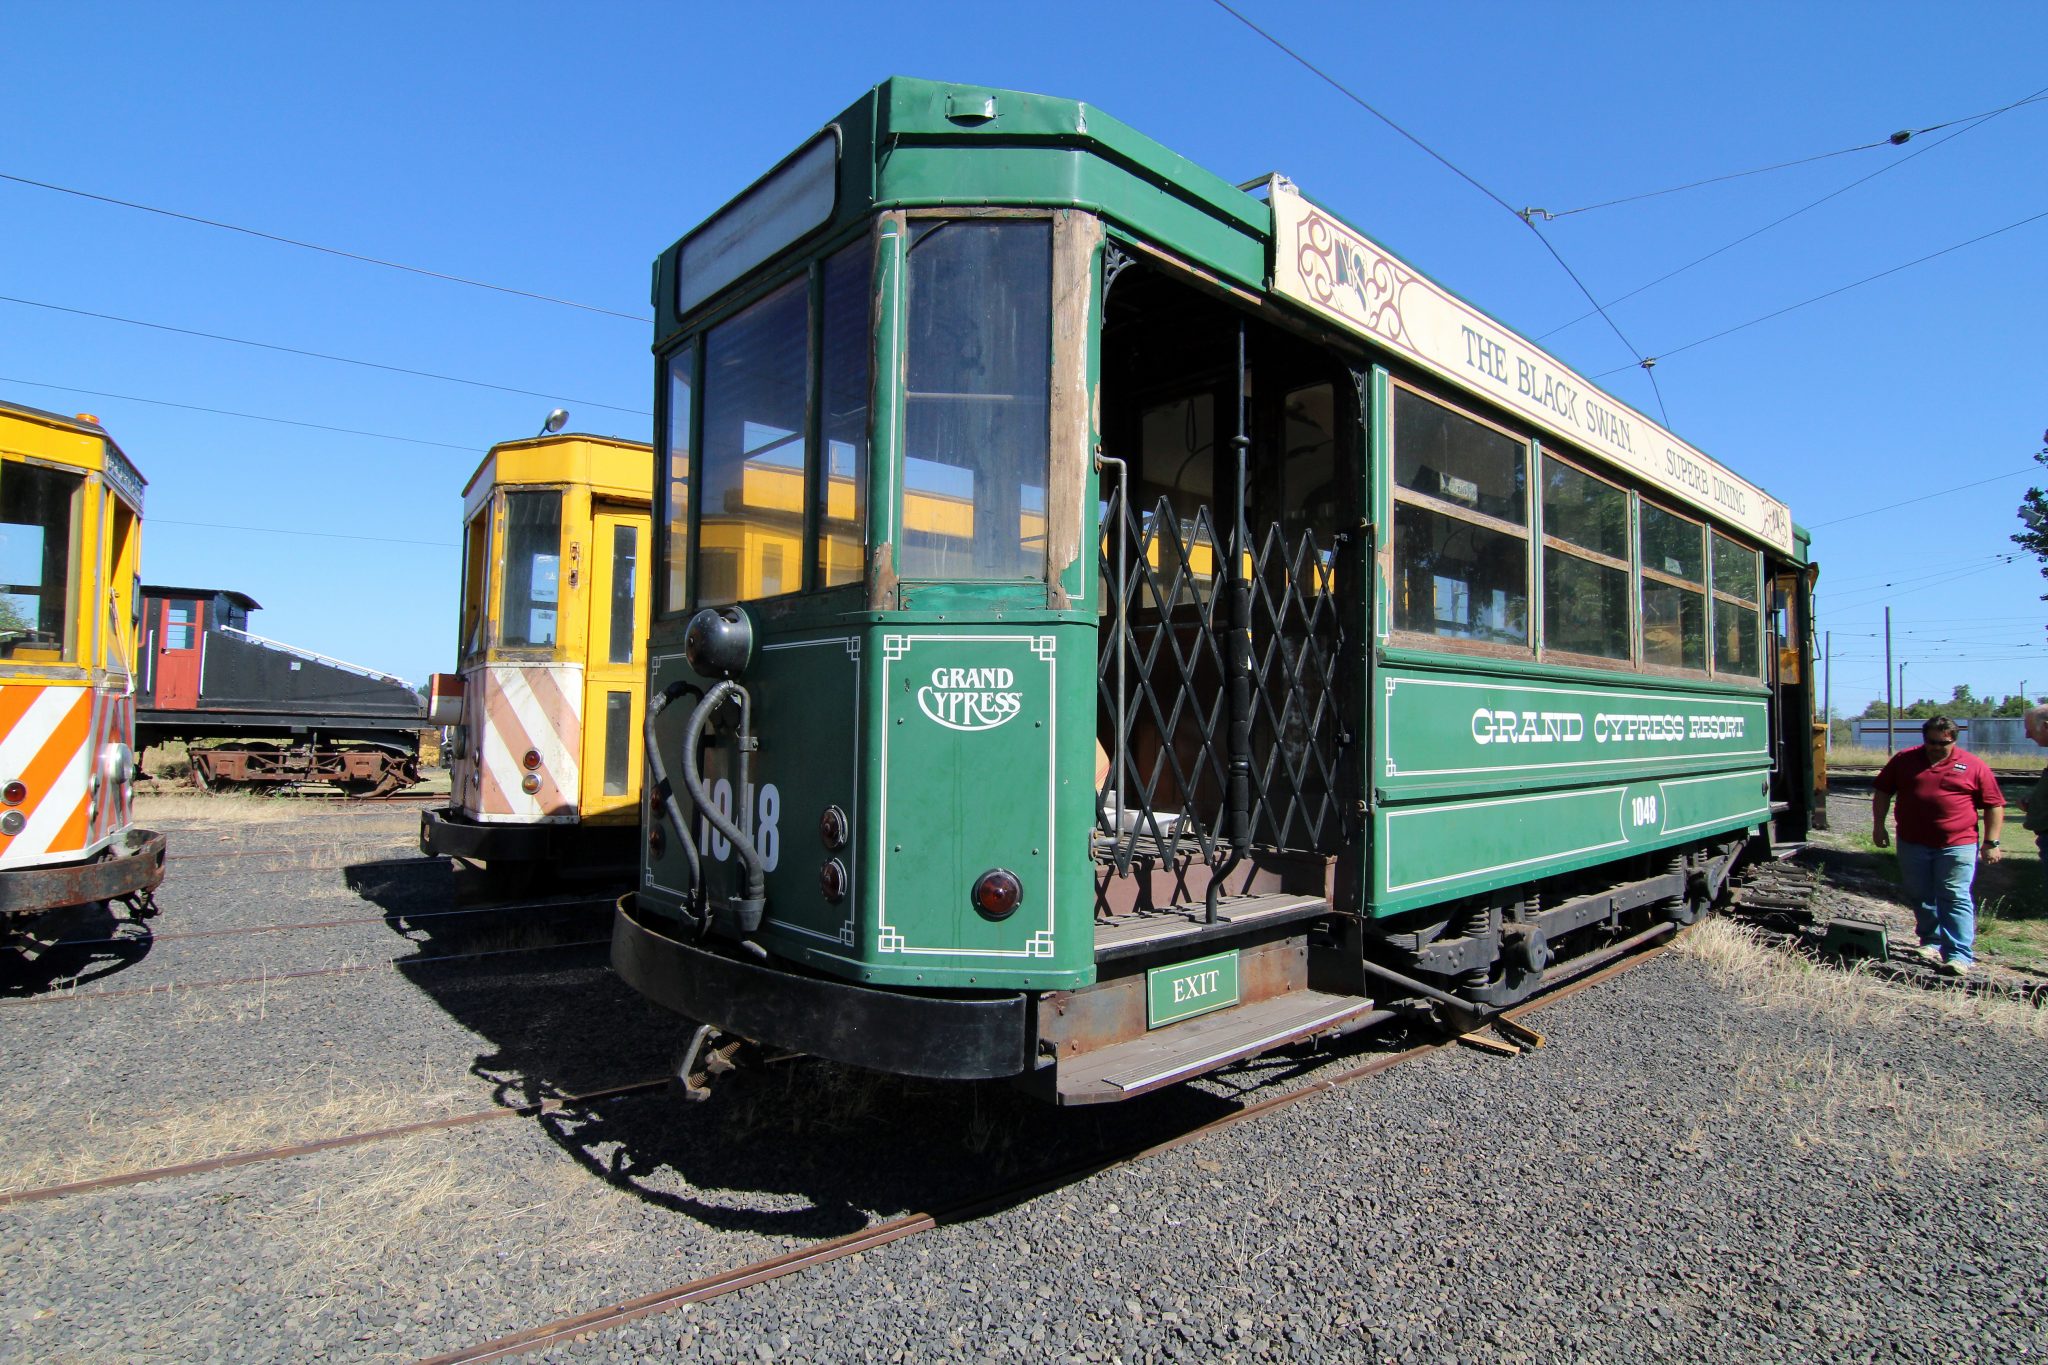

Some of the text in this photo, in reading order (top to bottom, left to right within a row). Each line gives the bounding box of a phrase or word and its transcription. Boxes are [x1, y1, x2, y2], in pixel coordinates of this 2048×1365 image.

[1461, 324, 1508, 386] THE
[1516, 356, 1581, 428] BLACK
[1666, 448, 1709, 495] SUPERB
[1713, 475, 1746, 516] DINING
[931, 667, 1014, 689] GRAND
[917, 686, 1021, 731] CYPRESS
[1471, 707, 1745, 745] GRAND CYPRESS RESORT
[1631, 795, 1657, 827] 1048
[1172, 969, 1220, 1004] EXIT
